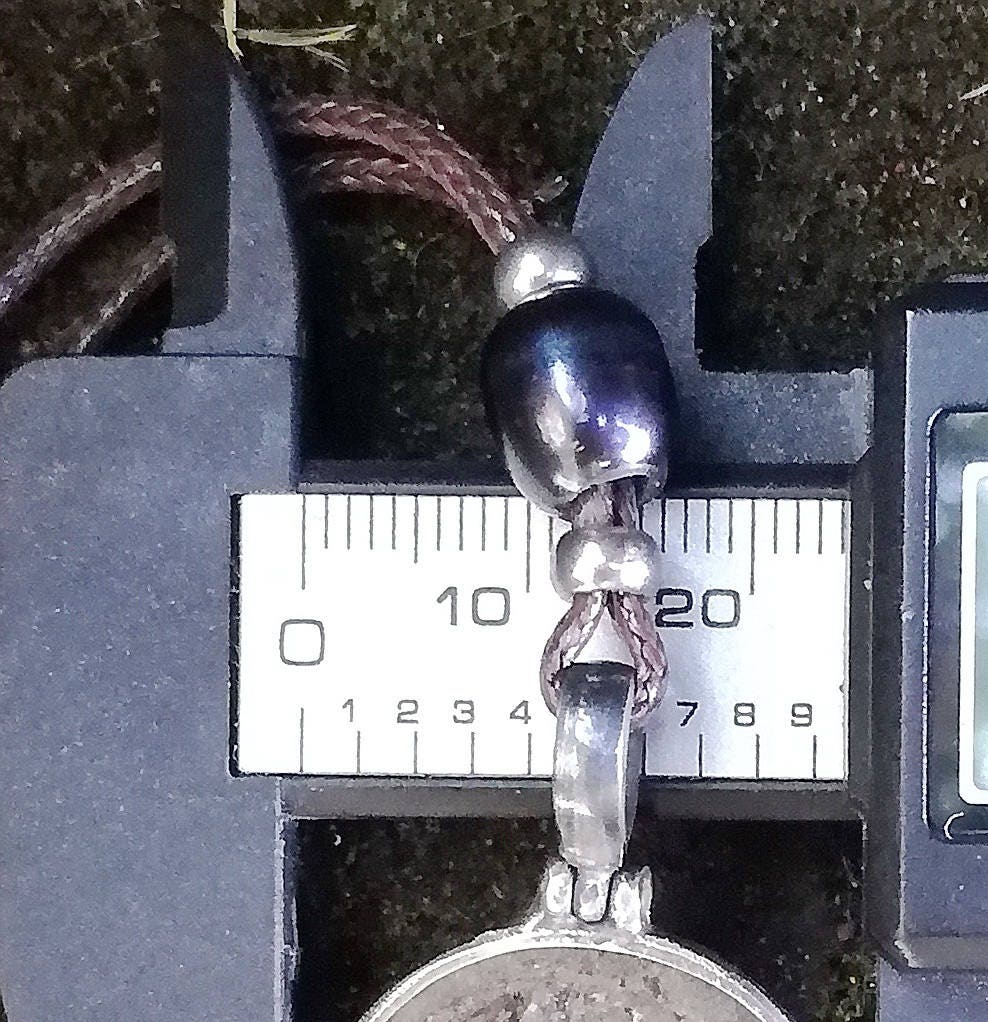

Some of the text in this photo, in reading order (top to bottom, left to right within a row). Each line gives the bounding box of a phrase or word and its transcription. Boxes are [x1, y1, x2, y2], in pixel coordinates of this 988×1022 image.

[436, 586, 741, 628] 10 20
[278, 618, 326, 667] 0
[341, 698, 813, 728] 1 2 3 4 7 8 9
